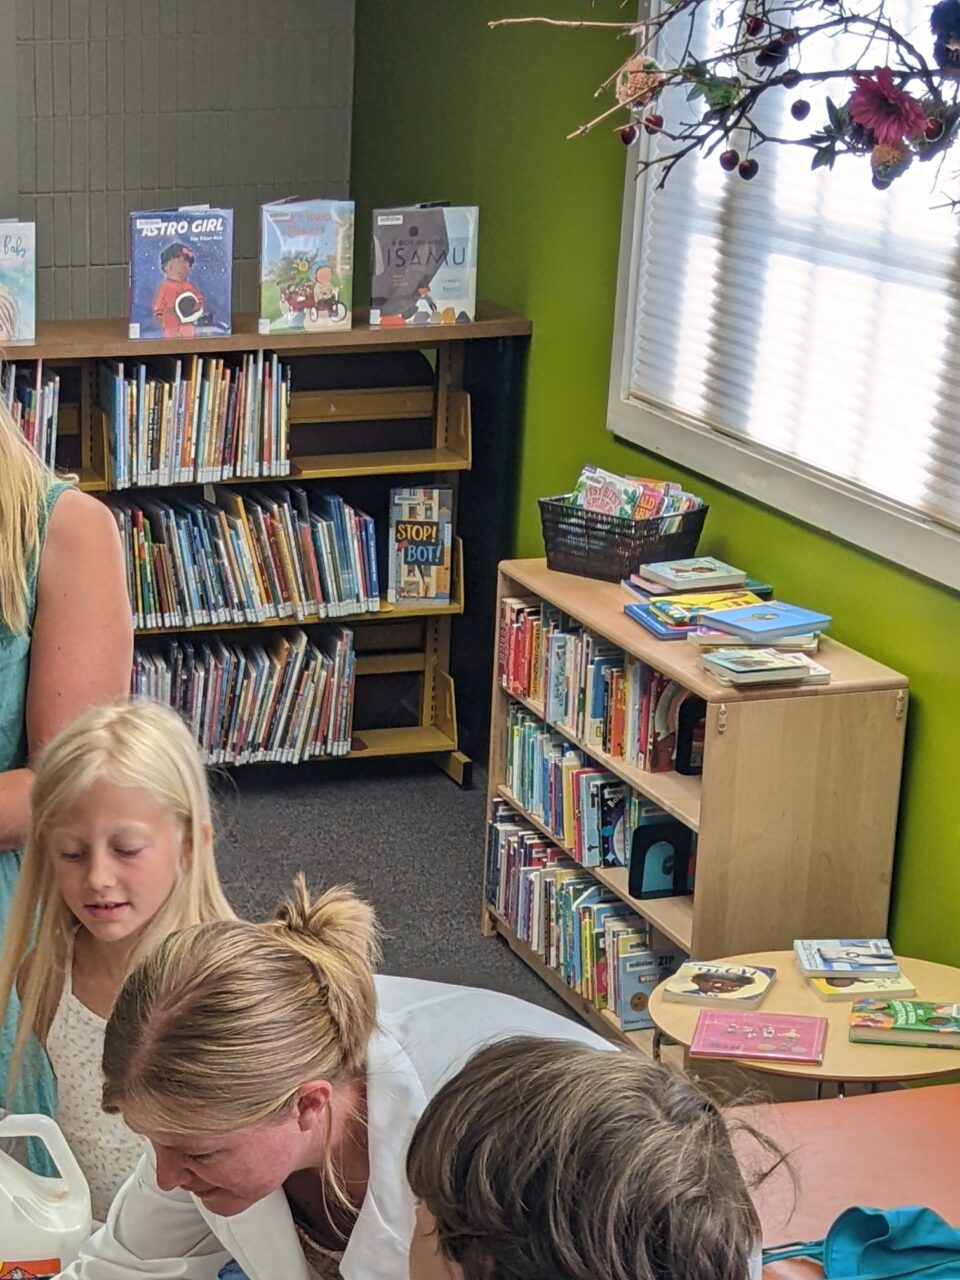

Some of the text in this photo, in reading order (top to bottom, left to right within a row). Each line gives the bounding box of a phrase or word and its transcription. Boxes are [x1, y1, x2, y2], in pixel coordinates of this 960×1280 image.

[142, 220, 188, 237] ASTRO
[191, 218, 223, 233] GIRL
[3, 235, 30, 259] Baby
[387, 247, 466, 267] ISAMU
[397, 524, 437, 543] STOP!
[407, 544, 442, 563] BOT!
[658, 955, 674, 966] ZIP
